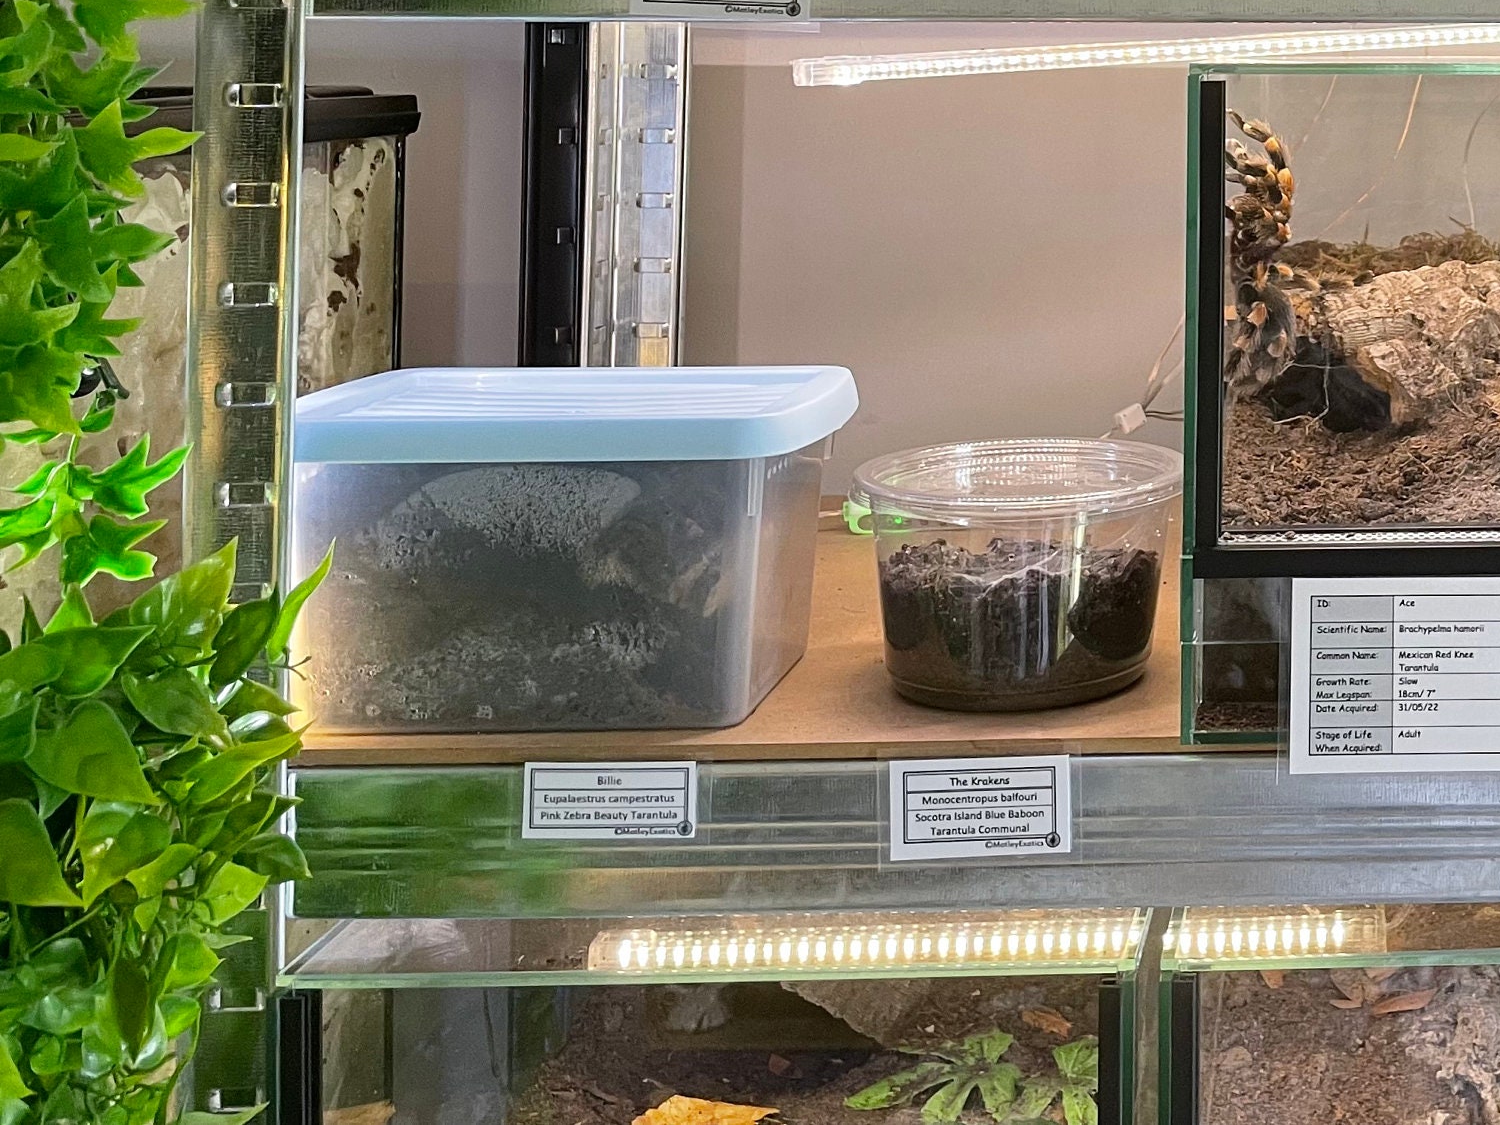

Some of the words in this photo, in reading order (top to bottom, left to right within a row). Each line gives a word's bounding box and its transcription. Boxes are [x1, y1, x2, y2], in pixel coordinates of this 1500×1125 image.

[1399, 599, 1416, 607] Ace
[1398, 625, 1452, 634] Brachypelma
[1454, 624, 1485, 633] hamorii
[1398, 651, 1433, 659] Mexican
[1435, 651, 1452, 659] Red
[1454, 651, 1474, 659] Knee
[1398, 703, 1438, 713] 31/05/22
[1398, 729, 1422, 739] Adult
[598, 776, 622, 785] Billie
[950, 778, 968, 786] The
[971, 777, 1010, 786] Krakens
[544, 794, 606, 803] Eupalaestrus
[608, 794, 675, 804] campestratus
[922, 795, 998, 805] Monocentropus
[1000, 793, 1037, 802] balfouri
[541, 811, 561, 820] Pink
[563, 811, 591, 820] Zebra
[594, 811, 628, 821] Beauty
[632, 811, 677, 820] Tarantula
[915, 812, 951, 822] Socotra
[954, 810, 982, 820] Island
[985, 810, 1005, 819] Blue
[1008, 809, 1044, 818] Baboon
[931, 826, 976, 836] Tarantula
[978, 823, 1030, 834] Communal
